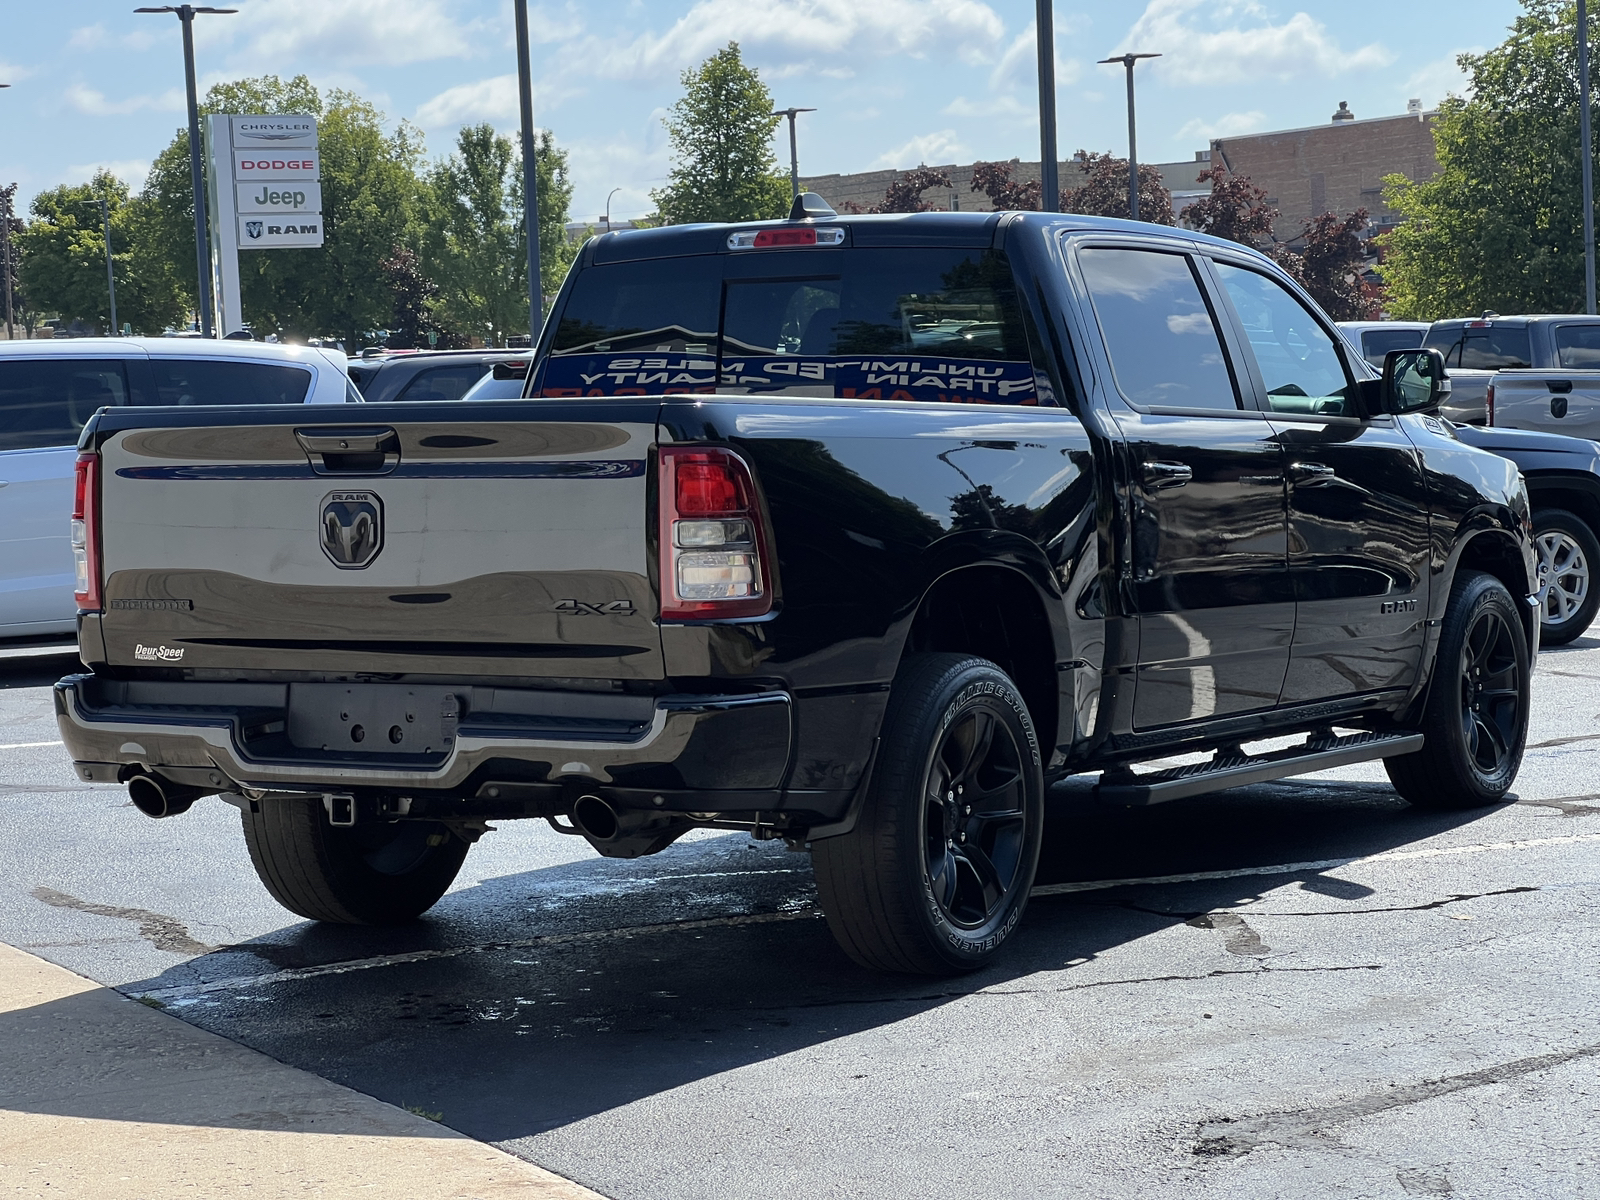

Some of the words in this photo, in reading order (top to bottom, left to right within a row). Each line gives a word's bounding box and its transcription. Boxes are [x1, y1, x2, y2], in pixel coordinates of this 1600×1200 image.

[241, 160, 314, 170] DODGE
[254, 186, 306, 209] Jeep
[267, 225, 318, 235] RAM
[1381, 599, 1417, 615] RAM
[942, 681, 1041, 767] BRIDGESTONE
[948, 906, 1018, 953] DUELER
